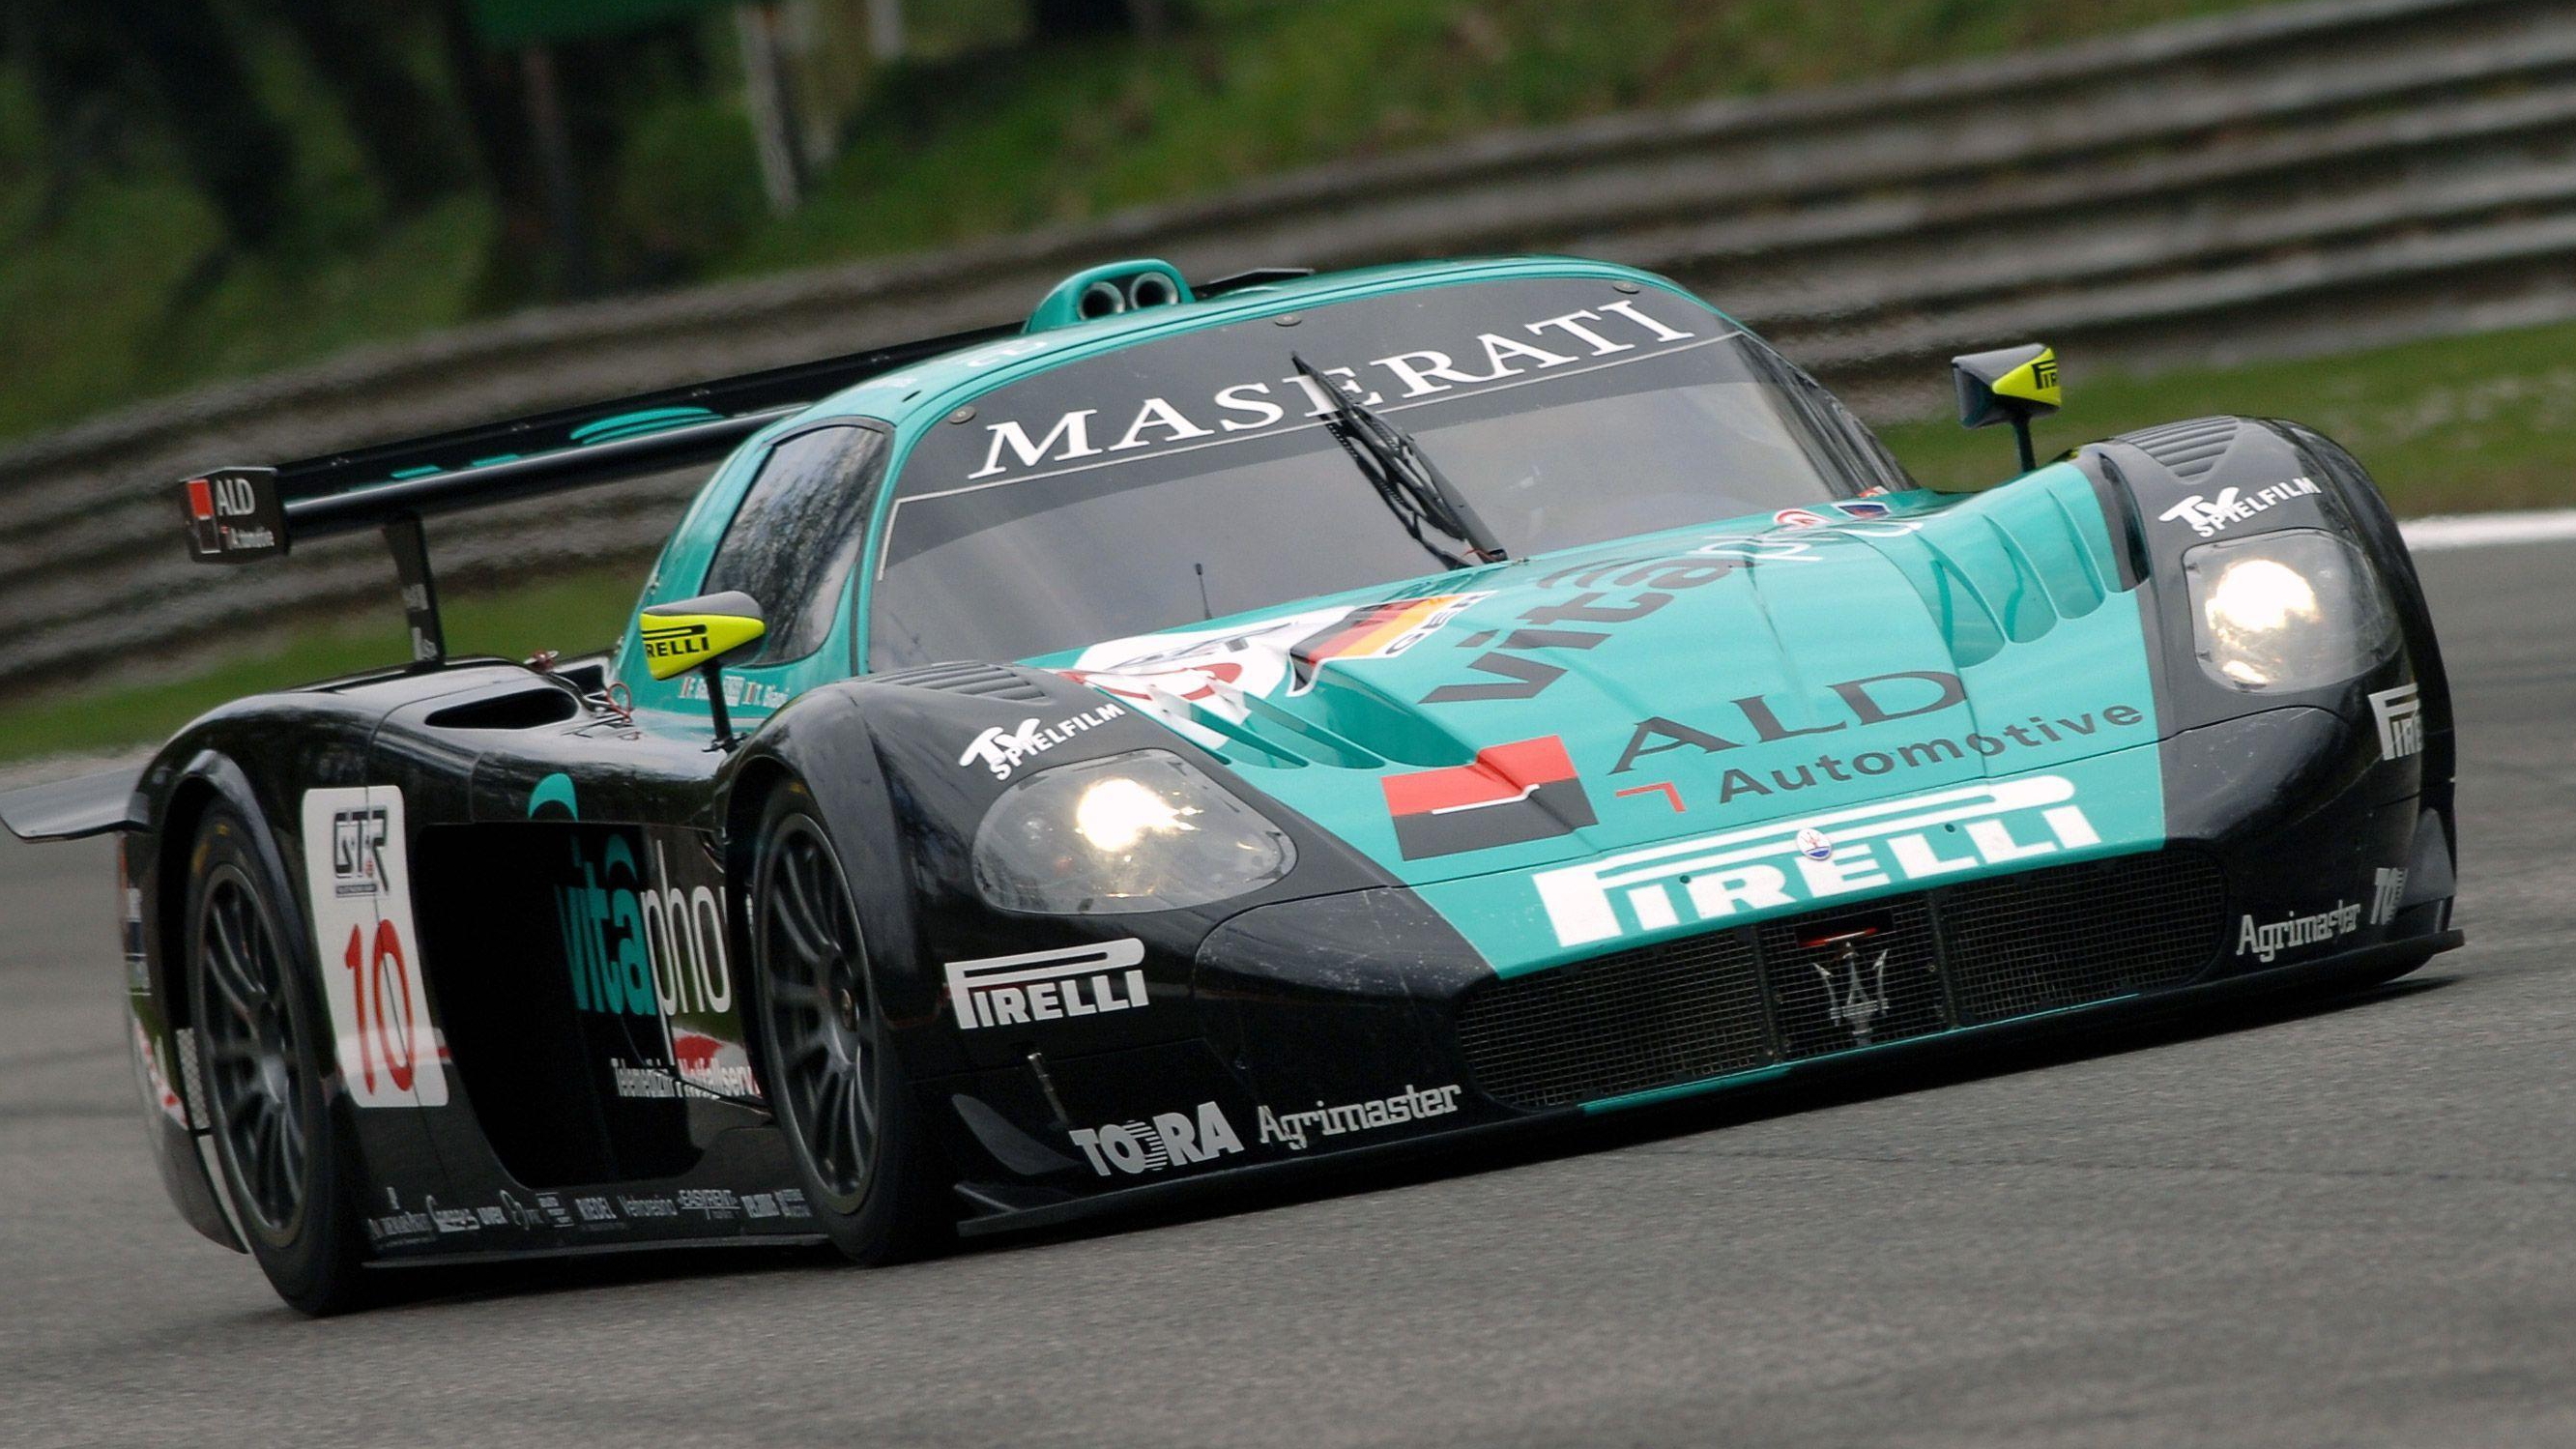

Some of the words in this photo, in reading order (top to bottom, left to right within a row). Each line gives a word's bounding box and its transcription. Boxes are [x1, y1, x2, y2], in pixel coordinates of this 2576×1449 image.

[969, 299, 1695, 480] MASERATI
[216, 478, 256, 516] ALD
[2191, 477, 2322, 537] SPIELFILM
[642, 624, 710, 658] RELLI
[990, 703, 1126, 781] SPIELFILM
[1606, 670, 1968, 775] ALD
[1720, 703, 2144, 804] Automotive
[1531, 774, 2102, 947] PIRELLI
[2236, 899, 2361, 962] Agrimaster
[345, 918, 415, 1095] 10
[943, 938, 1149, 1029] PIRELLI
[1069, 1101, 1245, 1176] TORA
[1258, 1084, 1462, 1150] Agrimaster
